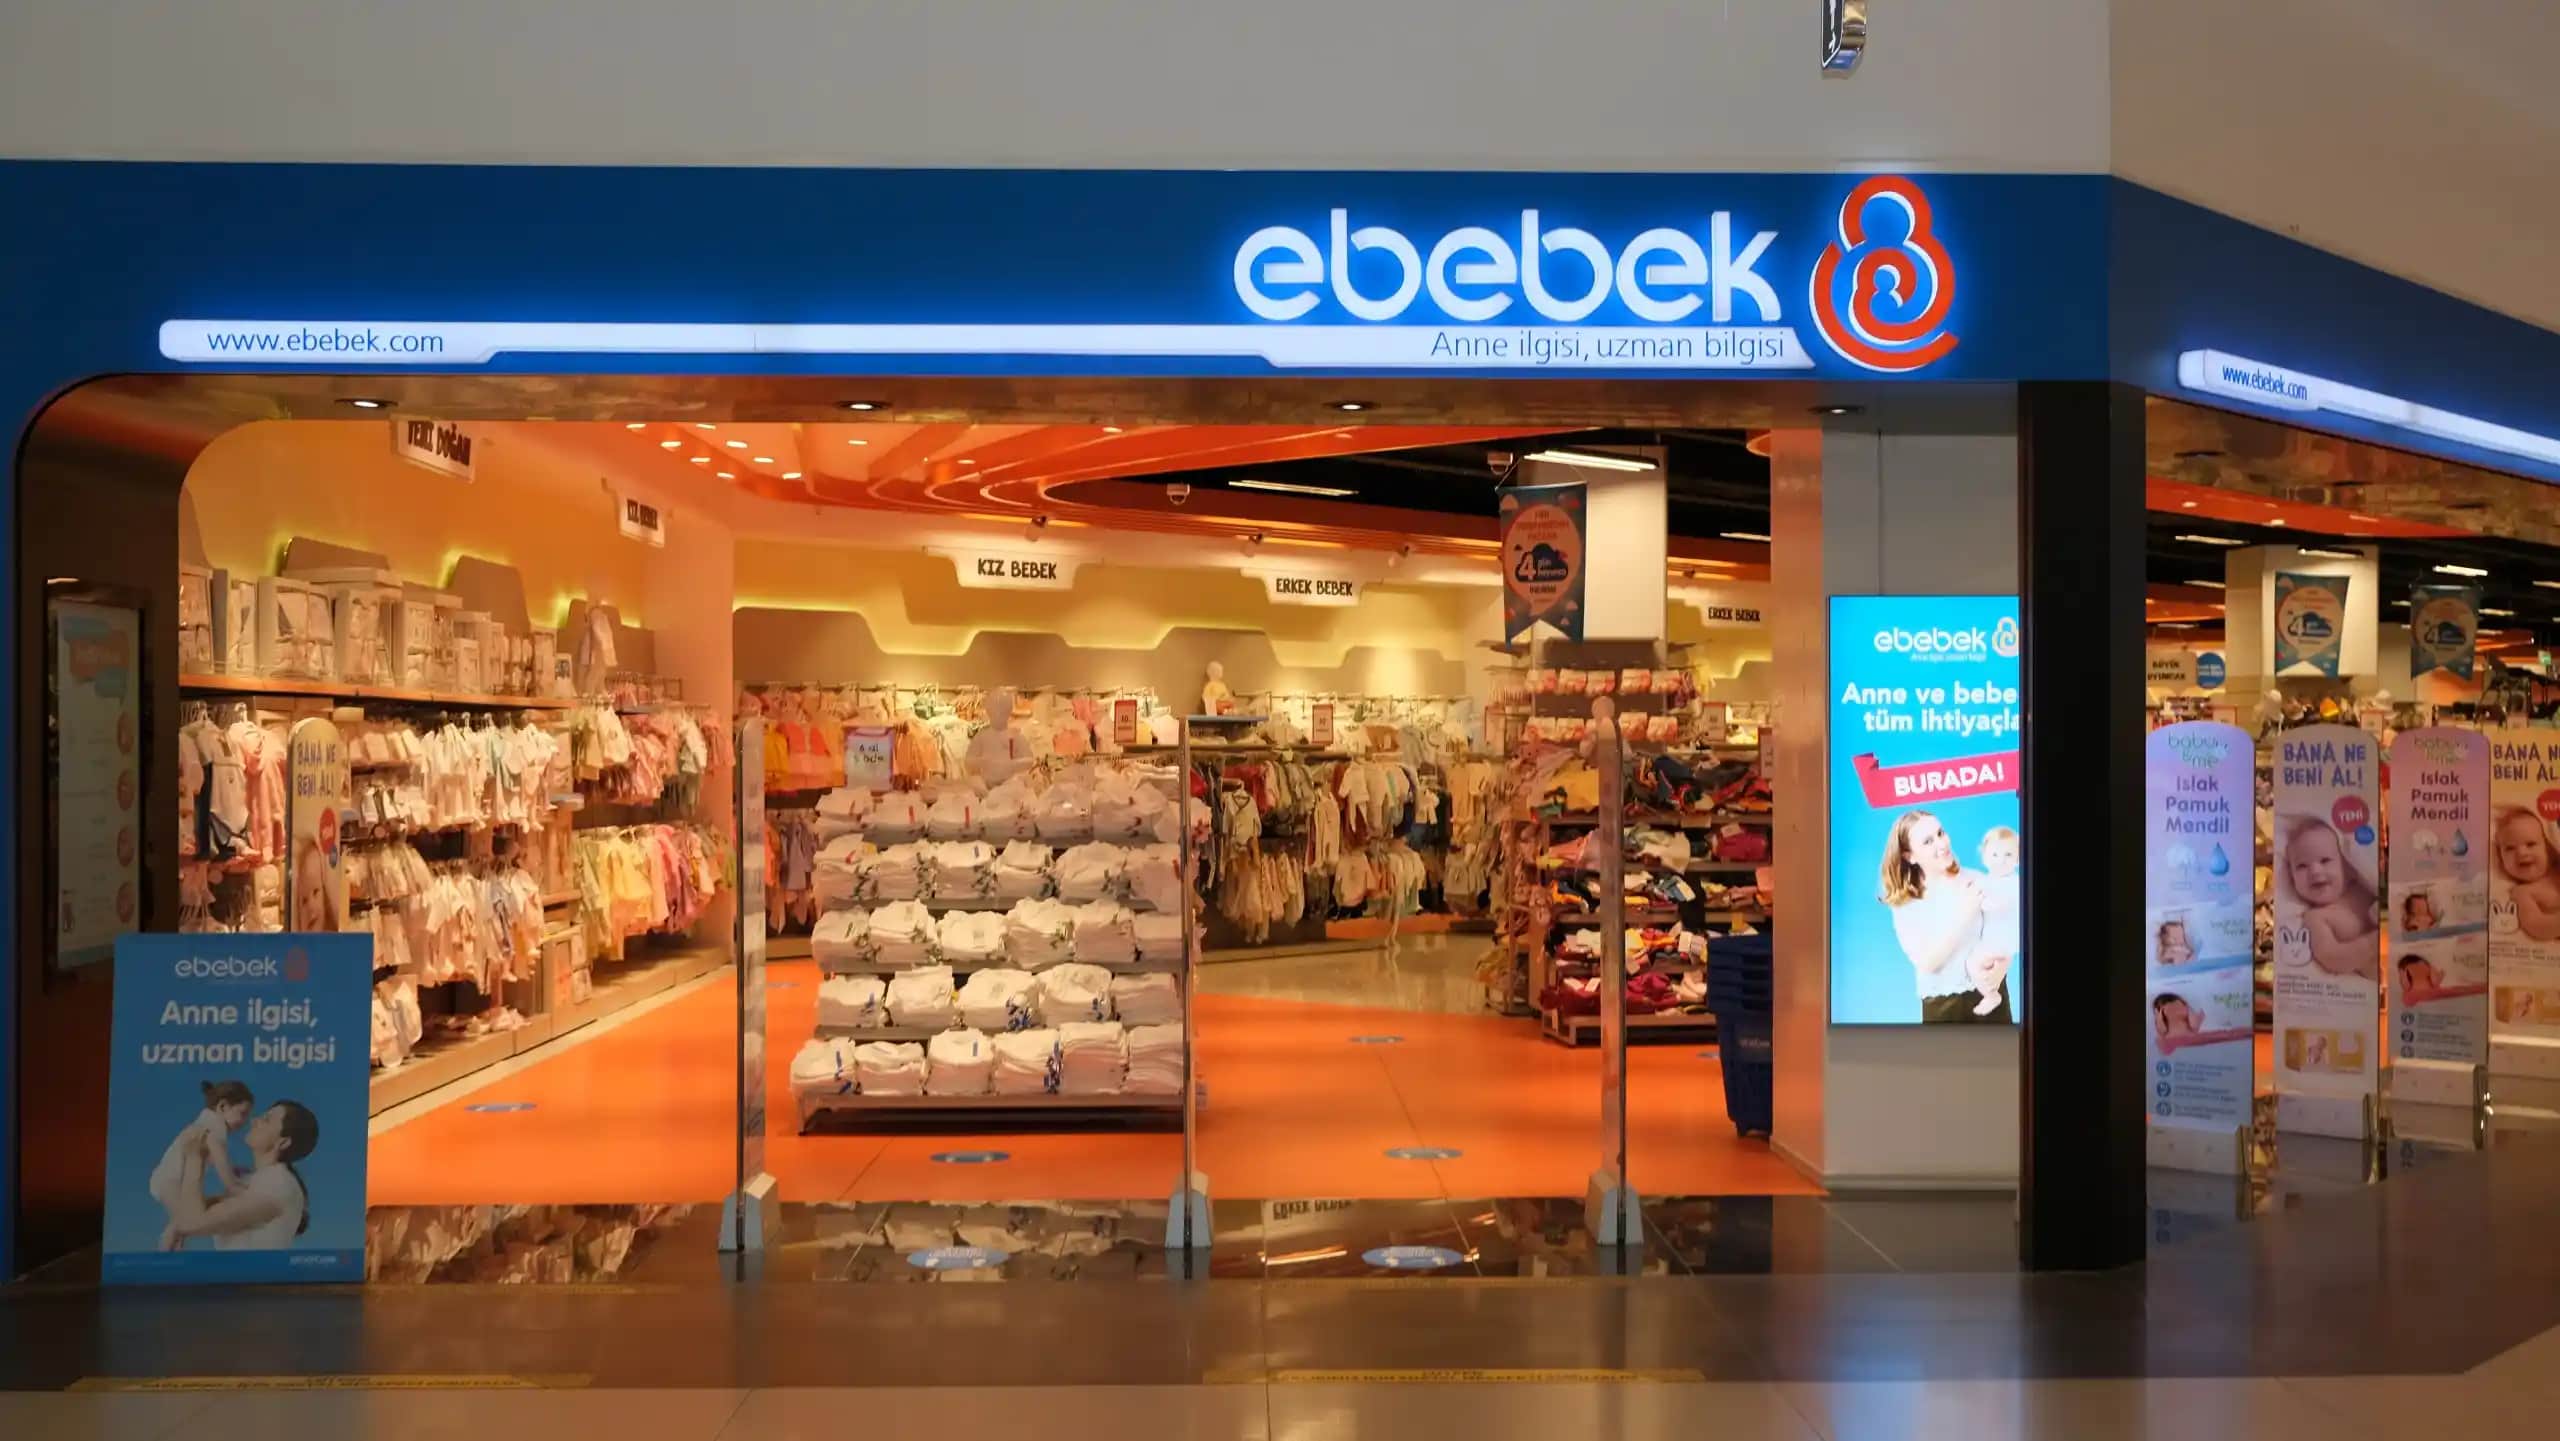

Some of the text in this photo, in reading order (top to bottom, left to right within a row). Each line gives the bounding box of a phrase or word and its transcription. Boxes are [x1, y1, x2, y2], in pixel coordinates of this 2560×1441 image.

[1234, 208, 1782, 321] ebebek
[207, 328, 444, 354] www.ebebek.com
[1430, 330, 1785, 365] Anne ilgisi, uzman bilgisi
[2222, 364, 2309, 401] www.ebebek.com
[977, 558, 1057, 580] KIZ BEBEK
[1276, 578, 1352, 596] ERKEK BEBEK
[1873, 626, 1987, 653] ebebek
[1841, 682, 1907, 705] Anne
[1915, 687, 1945, 705] ve
[1863, 708, 1913, 732] tüm
[2284, 741, 2366, 763] BANA NE
[2494, 741, 2541, 761] BANA
[1894, 760, 2004, 797] BURADA!
[2177, 775, 2219, 792] Islak
[2331, 764, 2363, 789] AL!
[2421, 770, 2460, 785] Islak
[2166, 795, 2231, 813] Pamuk
[2411, 788, 2469, 803] Pamuk
[2166, 815, 2230, 834] Mendil
[2411, 806, 2469, 821] Mendil
[175, 956, 278, 977] ebebek
[160, 998, 318, 1031] Anne ilgisi,
[142, 1036, 336, 1069] uzman bilgisi
